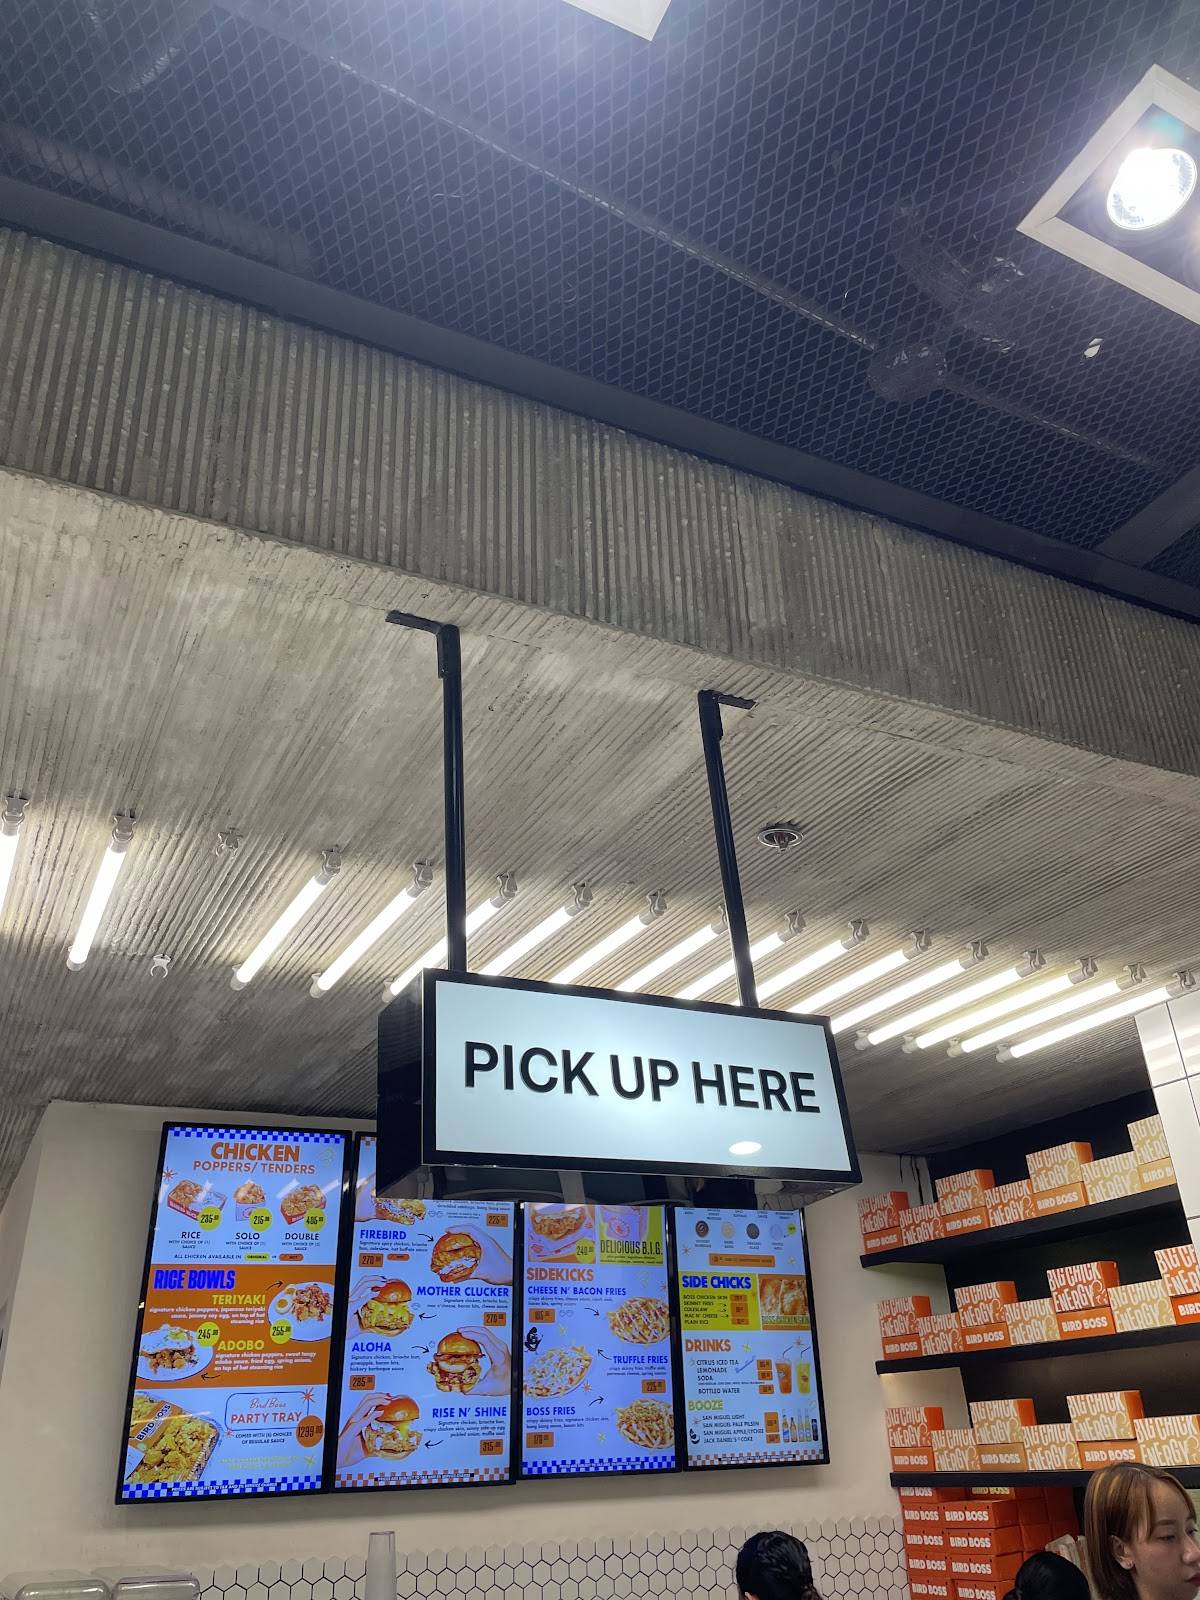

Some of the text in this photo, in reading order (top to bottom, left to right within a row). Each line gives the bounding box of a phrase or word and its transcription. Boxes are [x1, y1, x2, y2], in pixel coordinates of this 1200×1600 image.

[465, 1041, 820, 1113] PICK UP HERE
[211, 1142, 300, 1161] CHICKEN
[1026, 1142, 1075, 1173] BIG CHICK
[261, 1164, 315, 1174] TENDERS
[1081, 1160, 1101, 1183] BIG
[1100, 1151, 1137, 1178] CHICK
[935, 1170, 978, 1196] BIG CHICK
[1031, 1164, 1069, 1193] ENERGY
[984, 1179, 1030, 1208] BIG CHICK
[1088, 1174, 1131, 1204] ENERGY
[940, 1190, 972, 1216] ENERGY
[1036, 1192, 1078, 1210] BIRD BOSS
[899, 1202, 941, 1228] BIG CHICK
[988, 1200, 1024, 1227] ENERGY
[236, 1232, 260, 1240] SOLO
[360, 1230, 406, 1239] FIREBIRD
[902, 1222, 934, 1246] ENERGY
[600, 1240, 663, 1255] DELICIOUS B.I.G.
[154, 1270, 236, 1289] RICE BOWLS
[527, 1267, 594, 1281] SIDEKICKS
[682, 1275, 752, 1289] SIDE CHICKS
[1047, 1261, 1101, 1291] BIG CHICK
[212, 1294, 266, 1305] TERIYAKI
[417, 1286, 509, 1296] MOTHER CLUCKER
[528, 1286, 557, 1294] CHEESE
[573, 1287, 603, 1295] BACON
[606, 1288, 626, 1296] FRIES
[954, 1282, 1000, 1308] BIG CHICK
[1052, 1282, 1095, 1313] ENERGY
[1107, 1279, 1168, 1309] BIG CHICK
[879, 1296, 914, 1316] BIG CHICK
[959, 1302, 994, 1328] ENERGY
[1004, 1297, 1054, 1323] BIG CHICK
[880, 1314, 910, 1337] ENERGY
[918, 1313, 958, 1337] BIG CHICK
[1062, 1317, 1108, 1332] BIRD BOSS
[1113, 1302, 1159, 1332] ENERGY
[966, 1331, 1004, 1344] BIRD BOSS
[1009, 1319, 1046, 1346] ENERGY
[218, 1340, 264, 1350] ADOBO
[352, 1342, 392, 1352] ALOHA
[685, 1339, 731, 1352] DRINKS
[921, 1332, 953, 1356] ENERGY
[250, 1398, 268, 1408] Bird
[433, 1408, 455, 1417] RISE
[475, 1407, 506, 1416] SHINE
[526, 1406, 576, 1416] BOSS FRIES
[688, 1400, 723, 1411] BOOZE
[969, 1400, 1017, 1423] BIG CHICK
[1066, 1391, 1125, 1418] BIG CHICK
[231, 1412, 302, 1424] PARTY TRAY
[887, 1407, 927, 1426] BIG CHICK
[137, 1422, 155, 1440] BIRD
[890, 1424, 920, 1447] ENERGY
[974, 1419, 1011, 1444] ENERGY
[1022, 1423, 1074, 1448] BIG CHICK
[1072, 1414, 1117, 1442] ENERGY
[1133, 1415, 1198, 1443] BIG CHICK
[931, 1428, 976, 1450] BIG CHICK
[935, 1448, 969, 1470] ENERGY
[981, 1454, 1020, 1464] BIRD BOSS
[1027, 1444, 1068, 1470] ENERGY
[1084, 1450, 1136, 1462] BIRD BOSS
[1139, 1438, 1190, 1467] ENERGY
[905, 1510, 939, 1520] BIRD BOSS
[945, 1511, 989, 1521] BIRD BOSS
[906, 1534, 943, 1546] BIRD BOSS
[950, 1537, 991, 1548] BIRD BOSS
[909, 1559, 946, 1571] BIRD BOSS
[952, 1562, 991, 1574] BIRD BOSS
[912, 1583, 947, 1596] BIRD BOSS
[958, 1588, 996, 1600] BIRD BOSS
